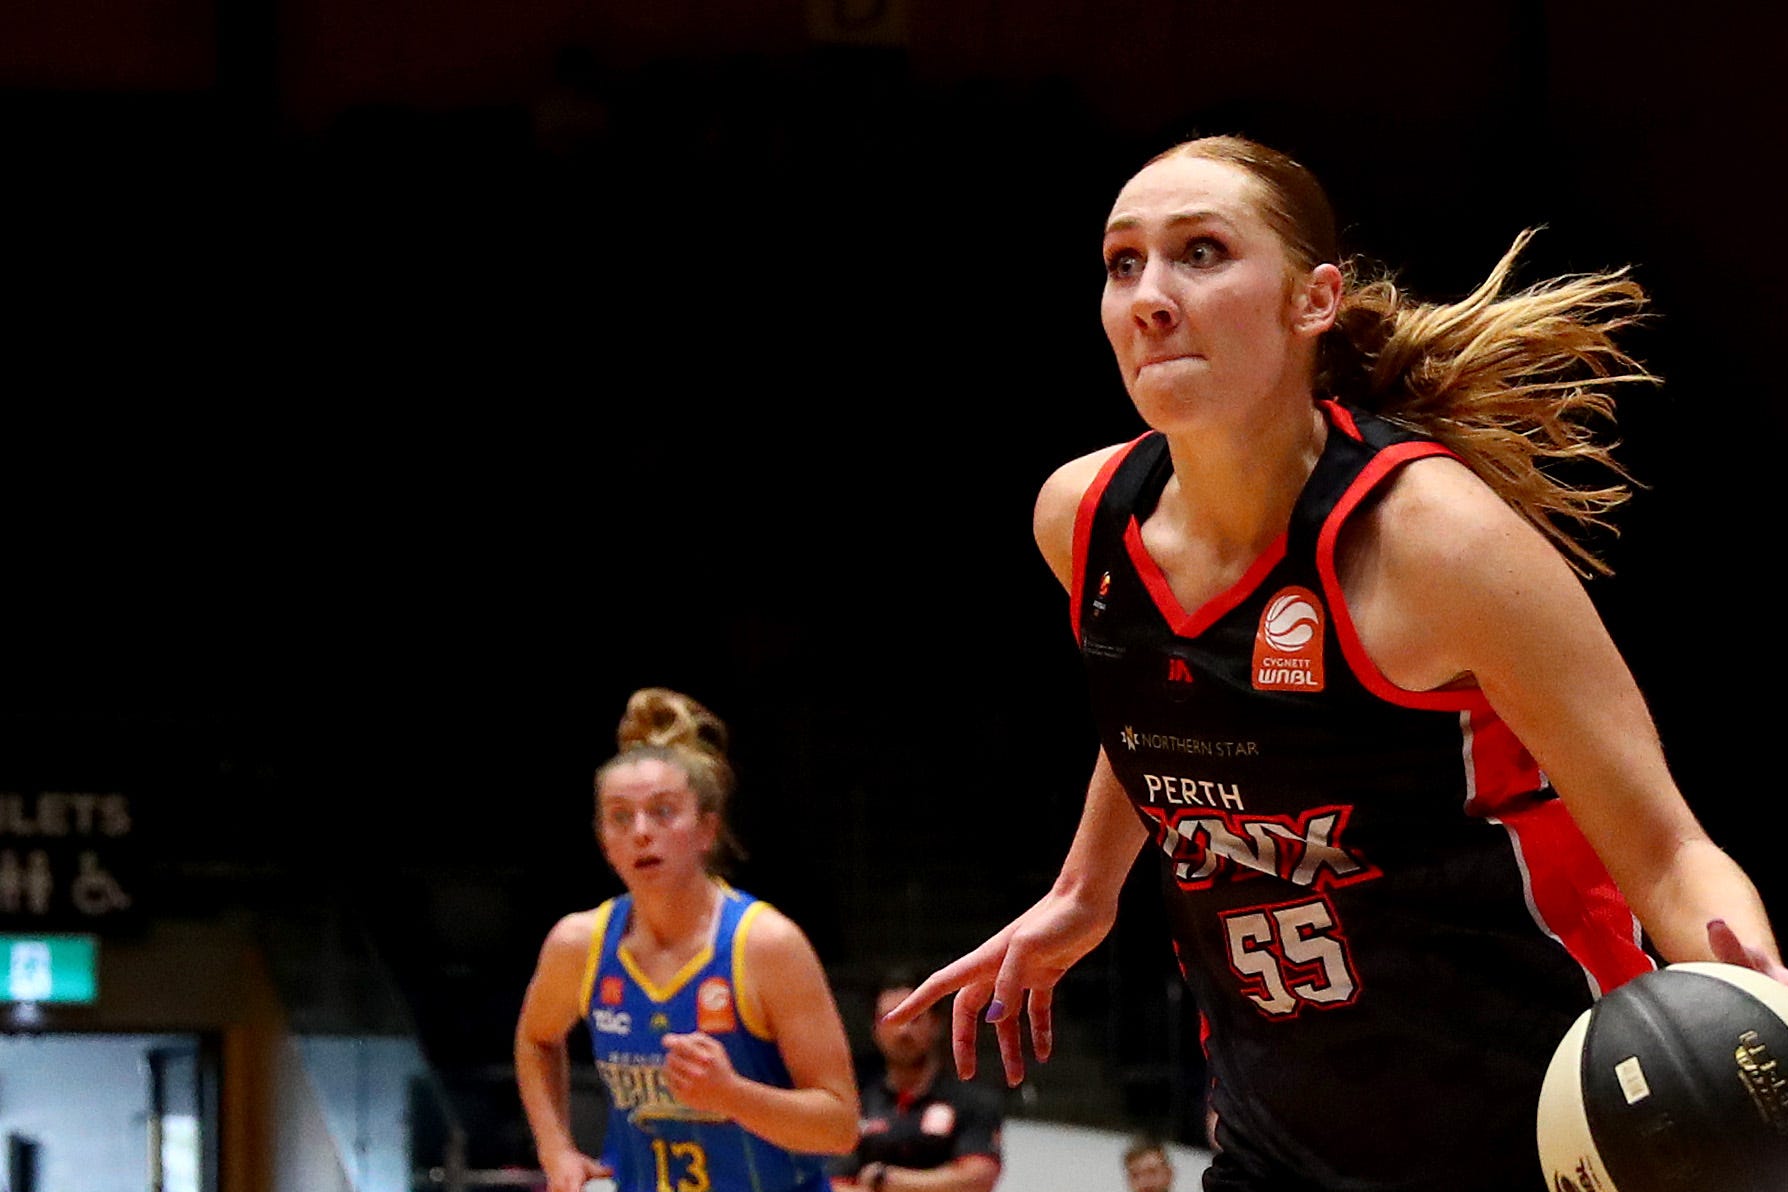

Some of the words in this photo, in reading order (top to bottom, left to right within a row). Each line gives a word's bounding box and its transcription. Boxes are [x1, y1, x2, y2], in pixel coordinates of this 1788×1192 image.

[1263, 657, 1311, 669] CYGNETT
[1257, 669, 1318, 686] WNBL
[1141, 733, 1213, 757] NORTHERN
[1214, 741, 1260, 758] STAR
[1143, 773, 1246, 812] PERTH
[1219, 897, 1361, 1021] 55
